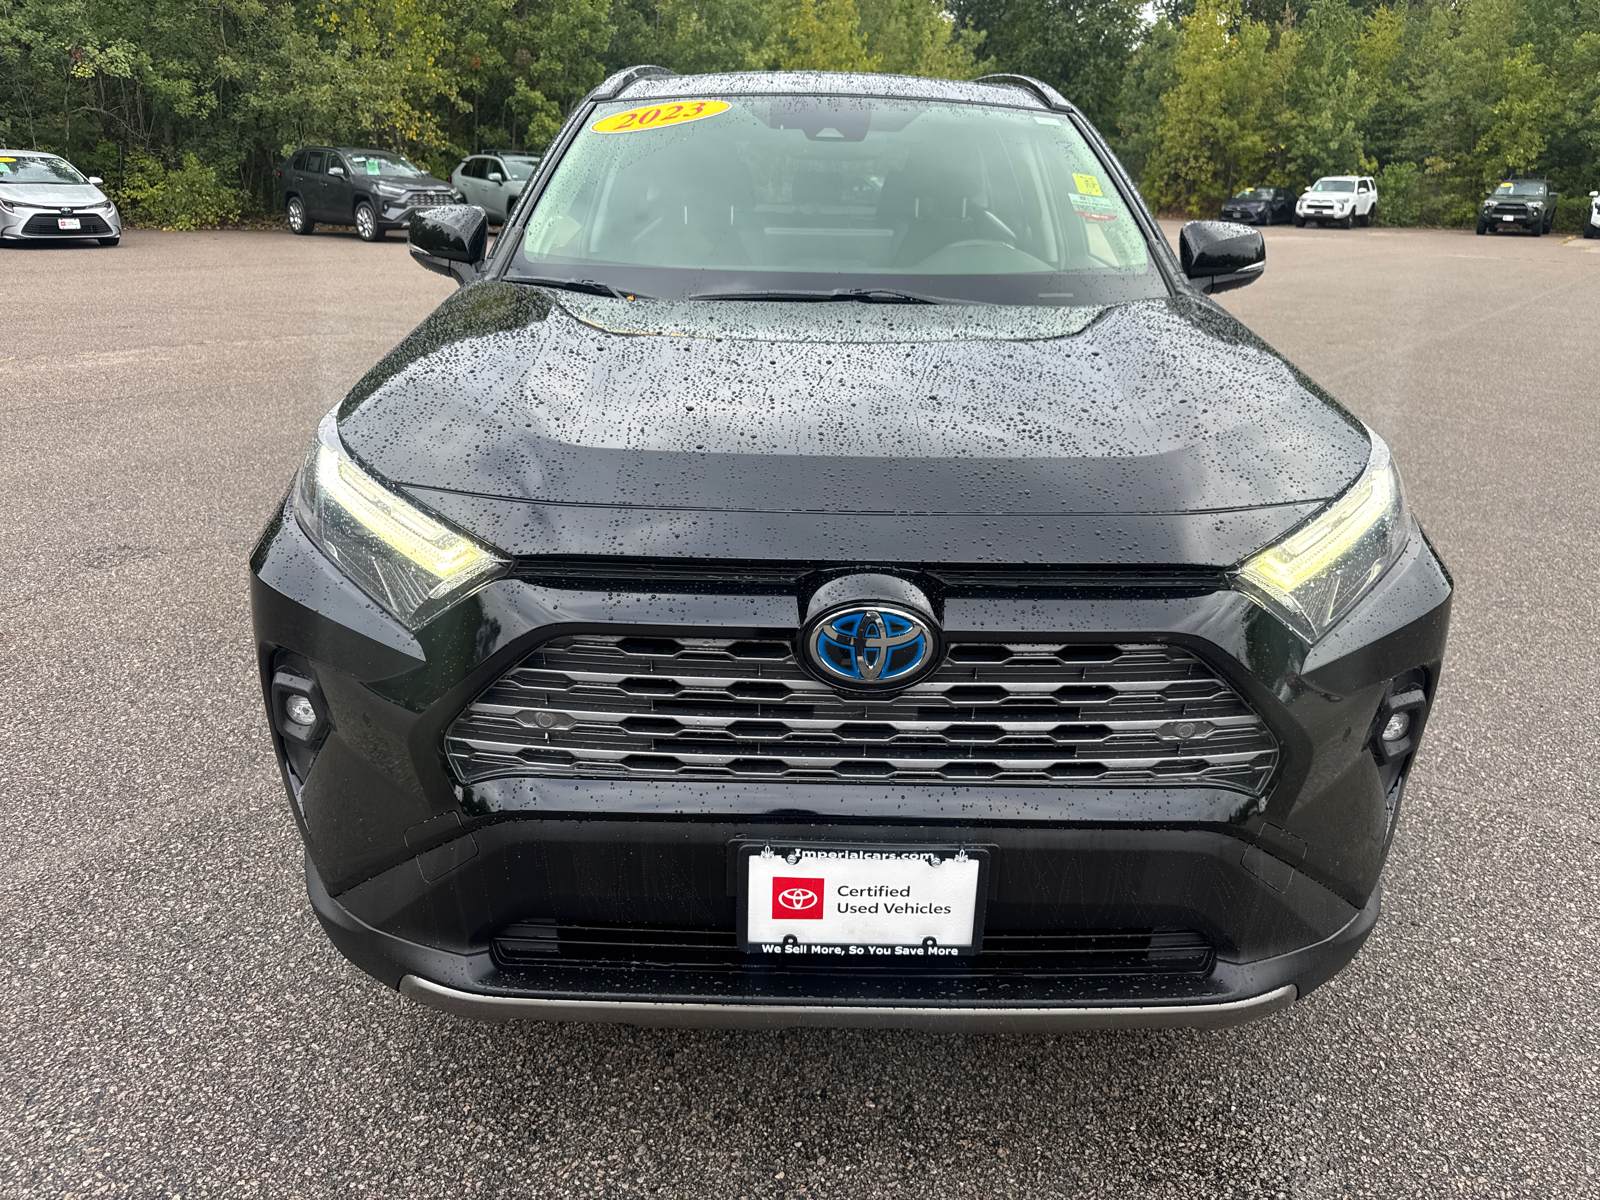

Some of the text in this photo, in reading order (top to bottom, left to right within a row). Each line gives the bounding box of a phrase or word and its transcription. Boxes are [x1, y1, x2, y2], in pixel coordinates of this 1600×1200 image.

[613, 102, 707, 131] 2023
[794, 848, 935, 861] Imperialcars.com
[837, 885, 911, 897] Certified
[837, 902, 952, 915] Used Vehicles
[761, 944, 959, 956] We Sell More, So You Save More
